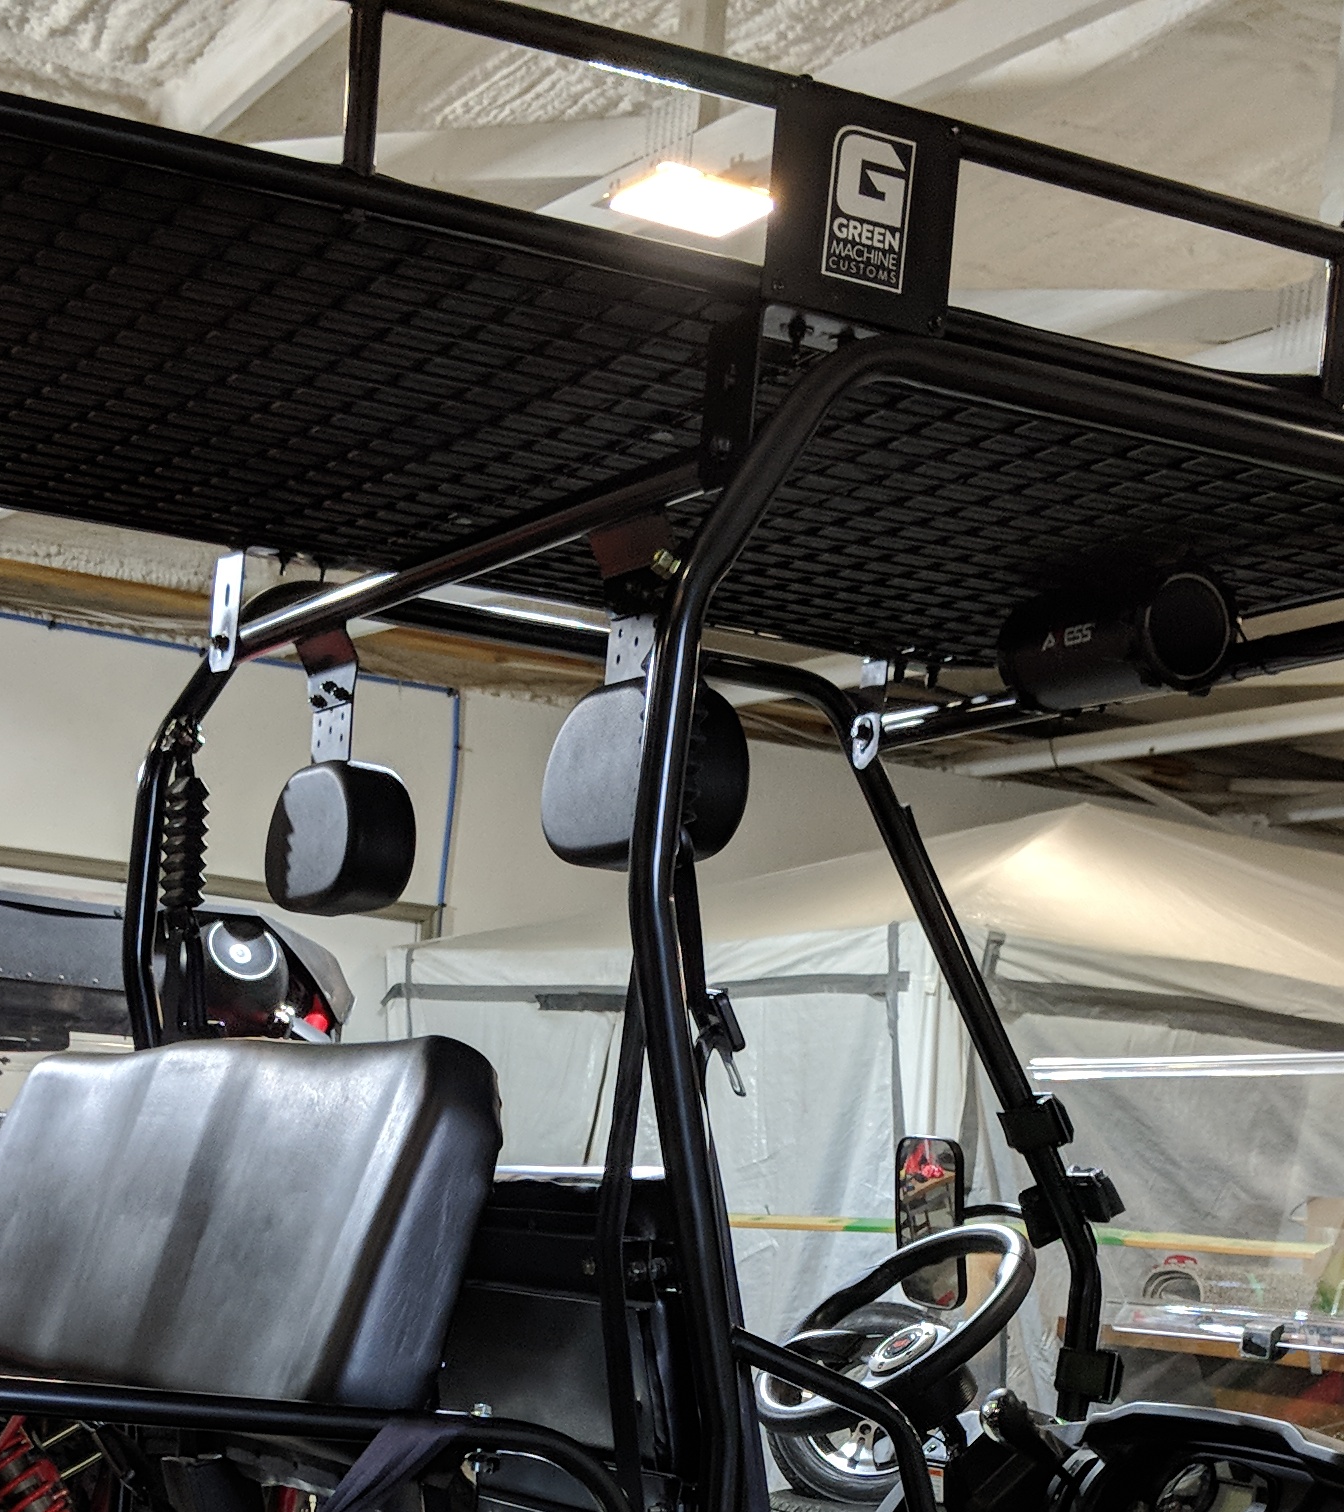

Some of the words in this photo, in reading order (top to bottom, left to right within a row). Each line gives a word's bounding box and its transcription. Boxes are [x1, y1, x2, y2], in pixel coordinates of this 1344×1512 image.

[832, 217, 900, 253] GREEN
[828, 256, 897, 284] CUSTOMS
[830, 240, 898, 271] MACHINE
